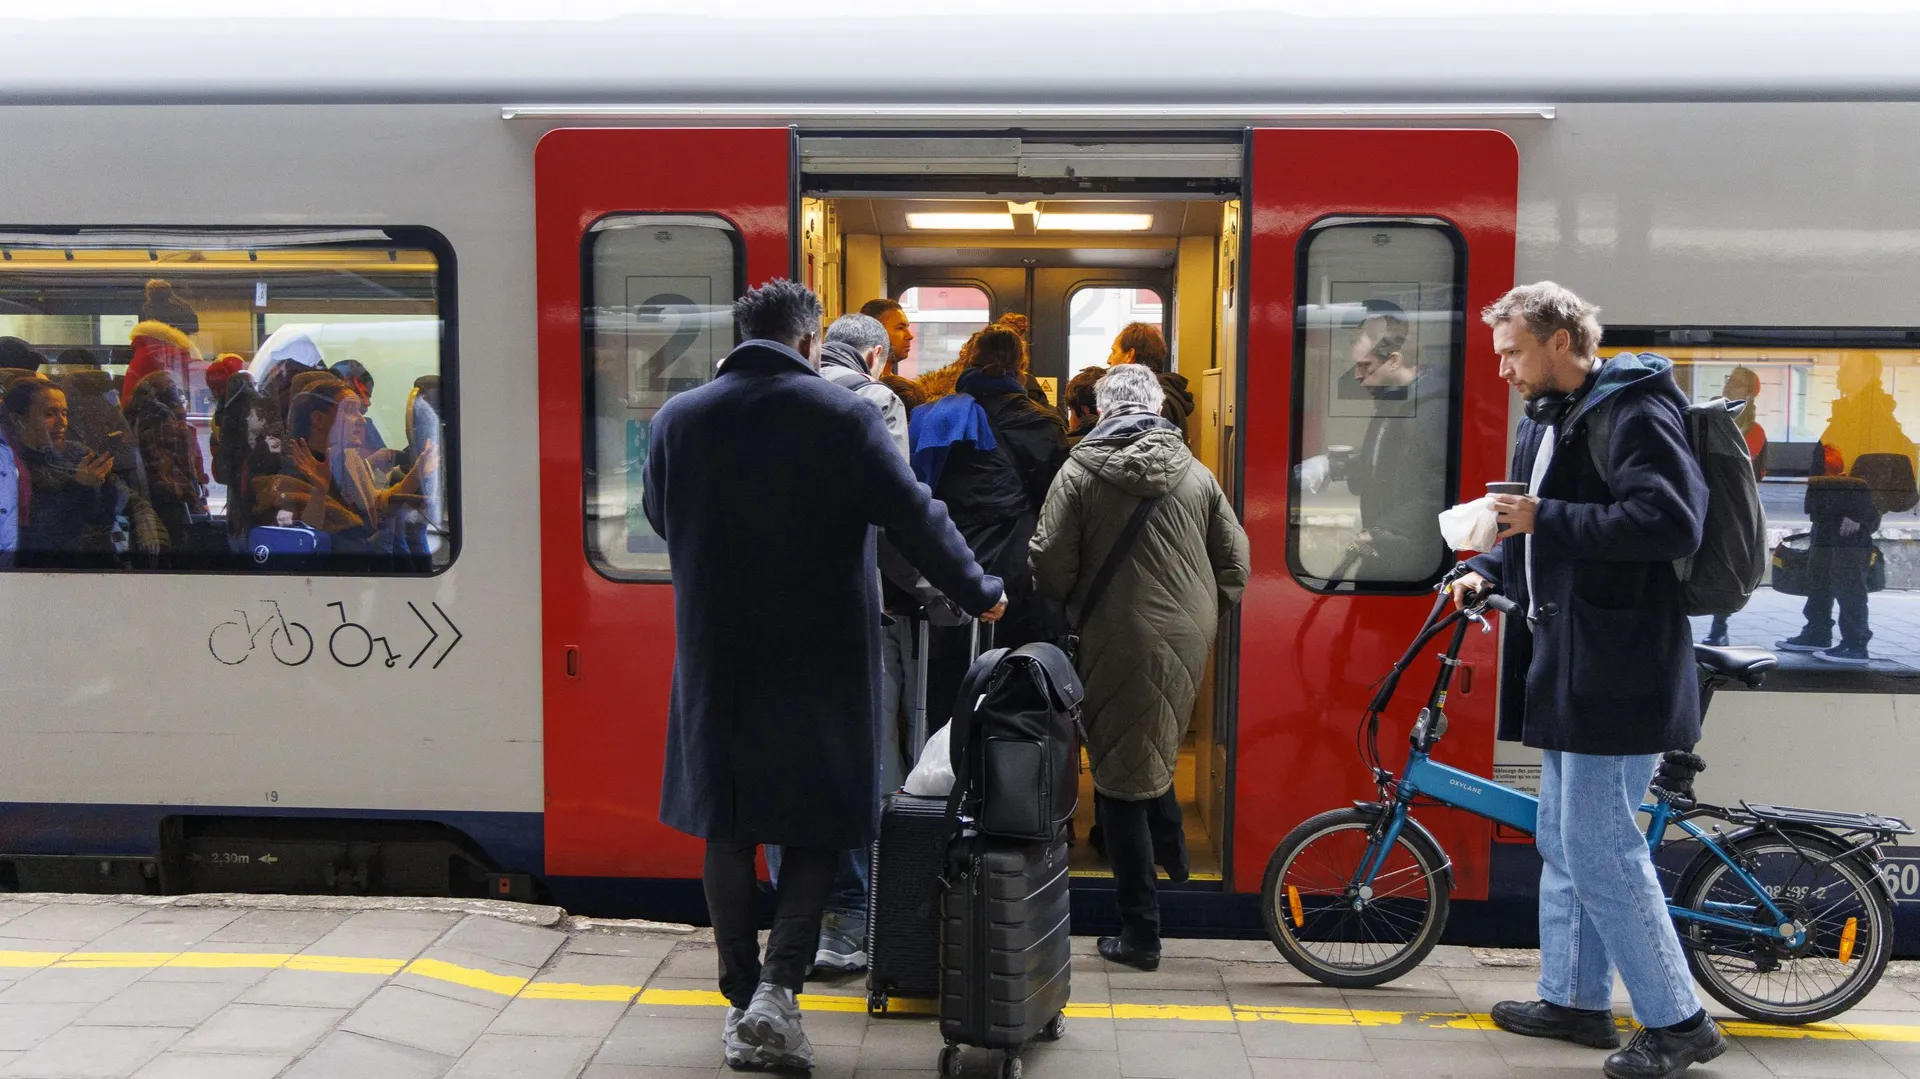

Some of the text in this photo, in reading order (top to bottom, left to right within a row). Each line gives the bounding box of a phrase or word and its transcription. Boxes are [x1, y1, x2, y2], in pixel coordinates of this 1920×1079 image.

[635, 293, 704, 392] 2
[1449, 779, 1483, 795] OXYLANE
[1883, 863, 1919, 896] 60
